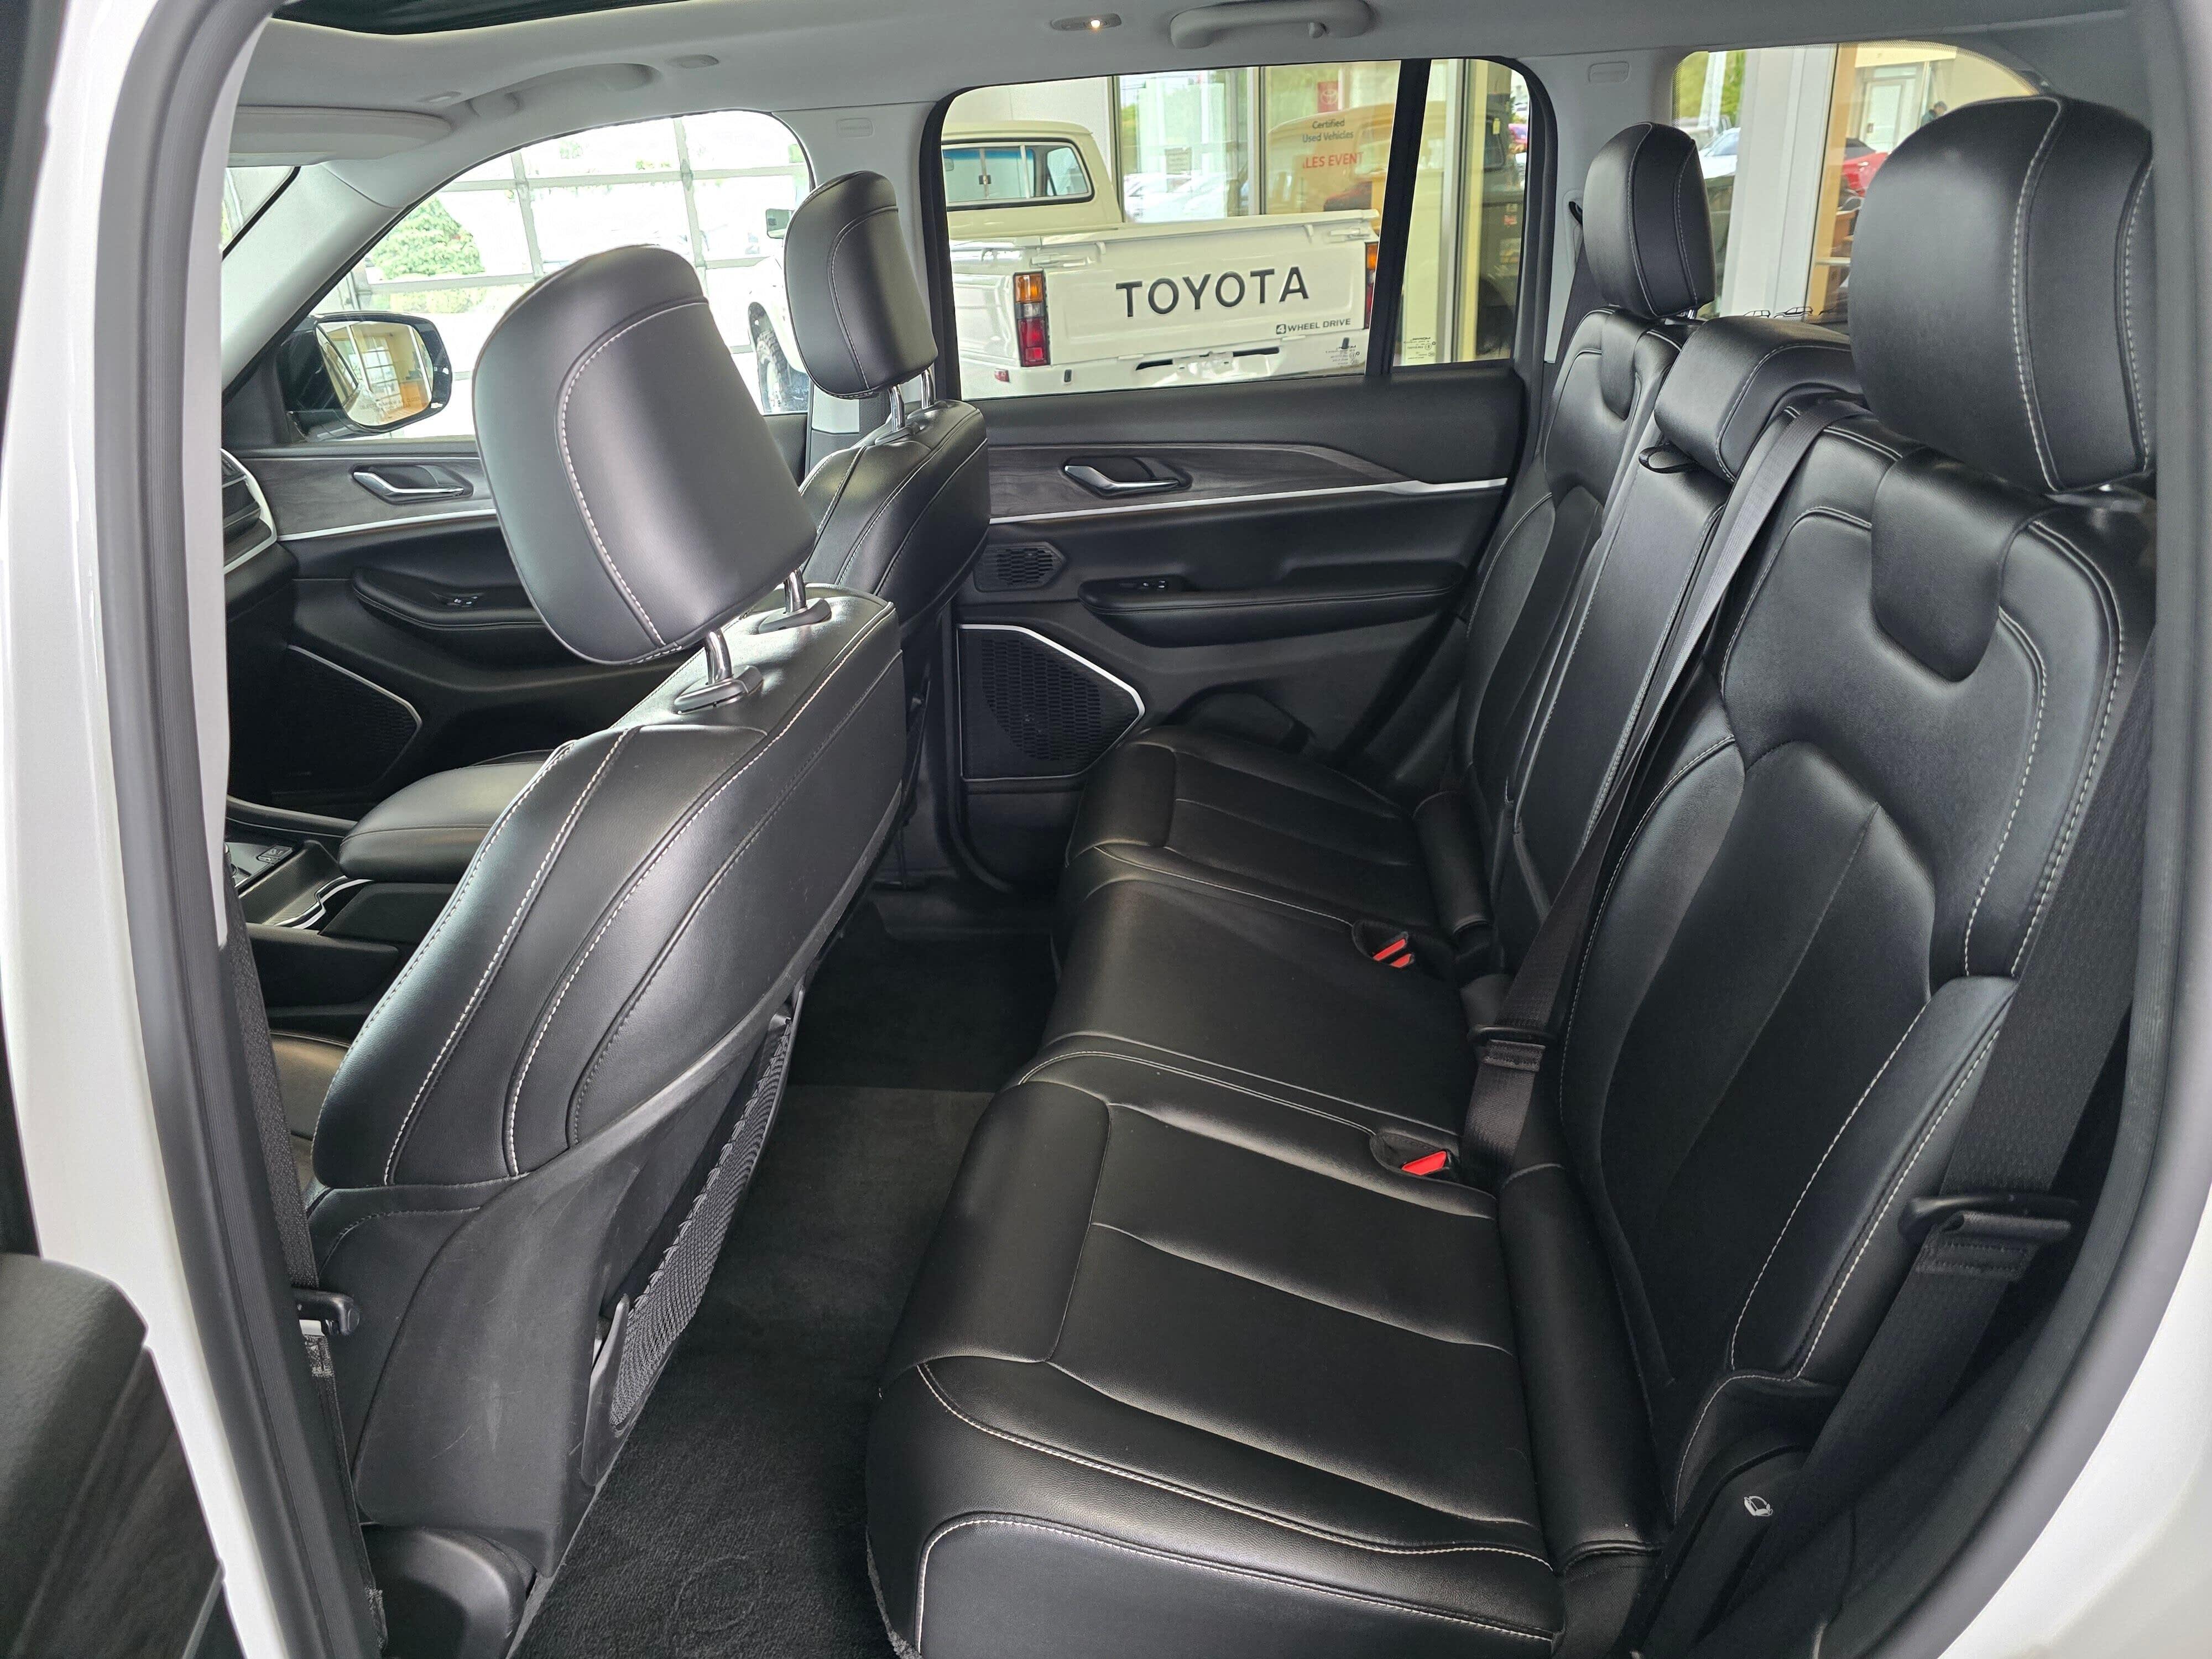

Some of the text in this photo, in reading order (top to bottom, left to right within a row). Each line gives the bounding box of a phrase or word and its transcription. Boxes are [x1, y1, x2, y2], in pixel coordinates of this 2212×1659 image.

[1312, 118, 1345, 129] Certified
[1302, 131, 1354, 143] Used Vehicles
[1328, 152, 1364, 166] EVENT
[1115, 266, 1310, 317] TOYOTA
[1287, 322, 1321, 332] WHEEL
[1323, 318, 1352, 328] DRIVE
